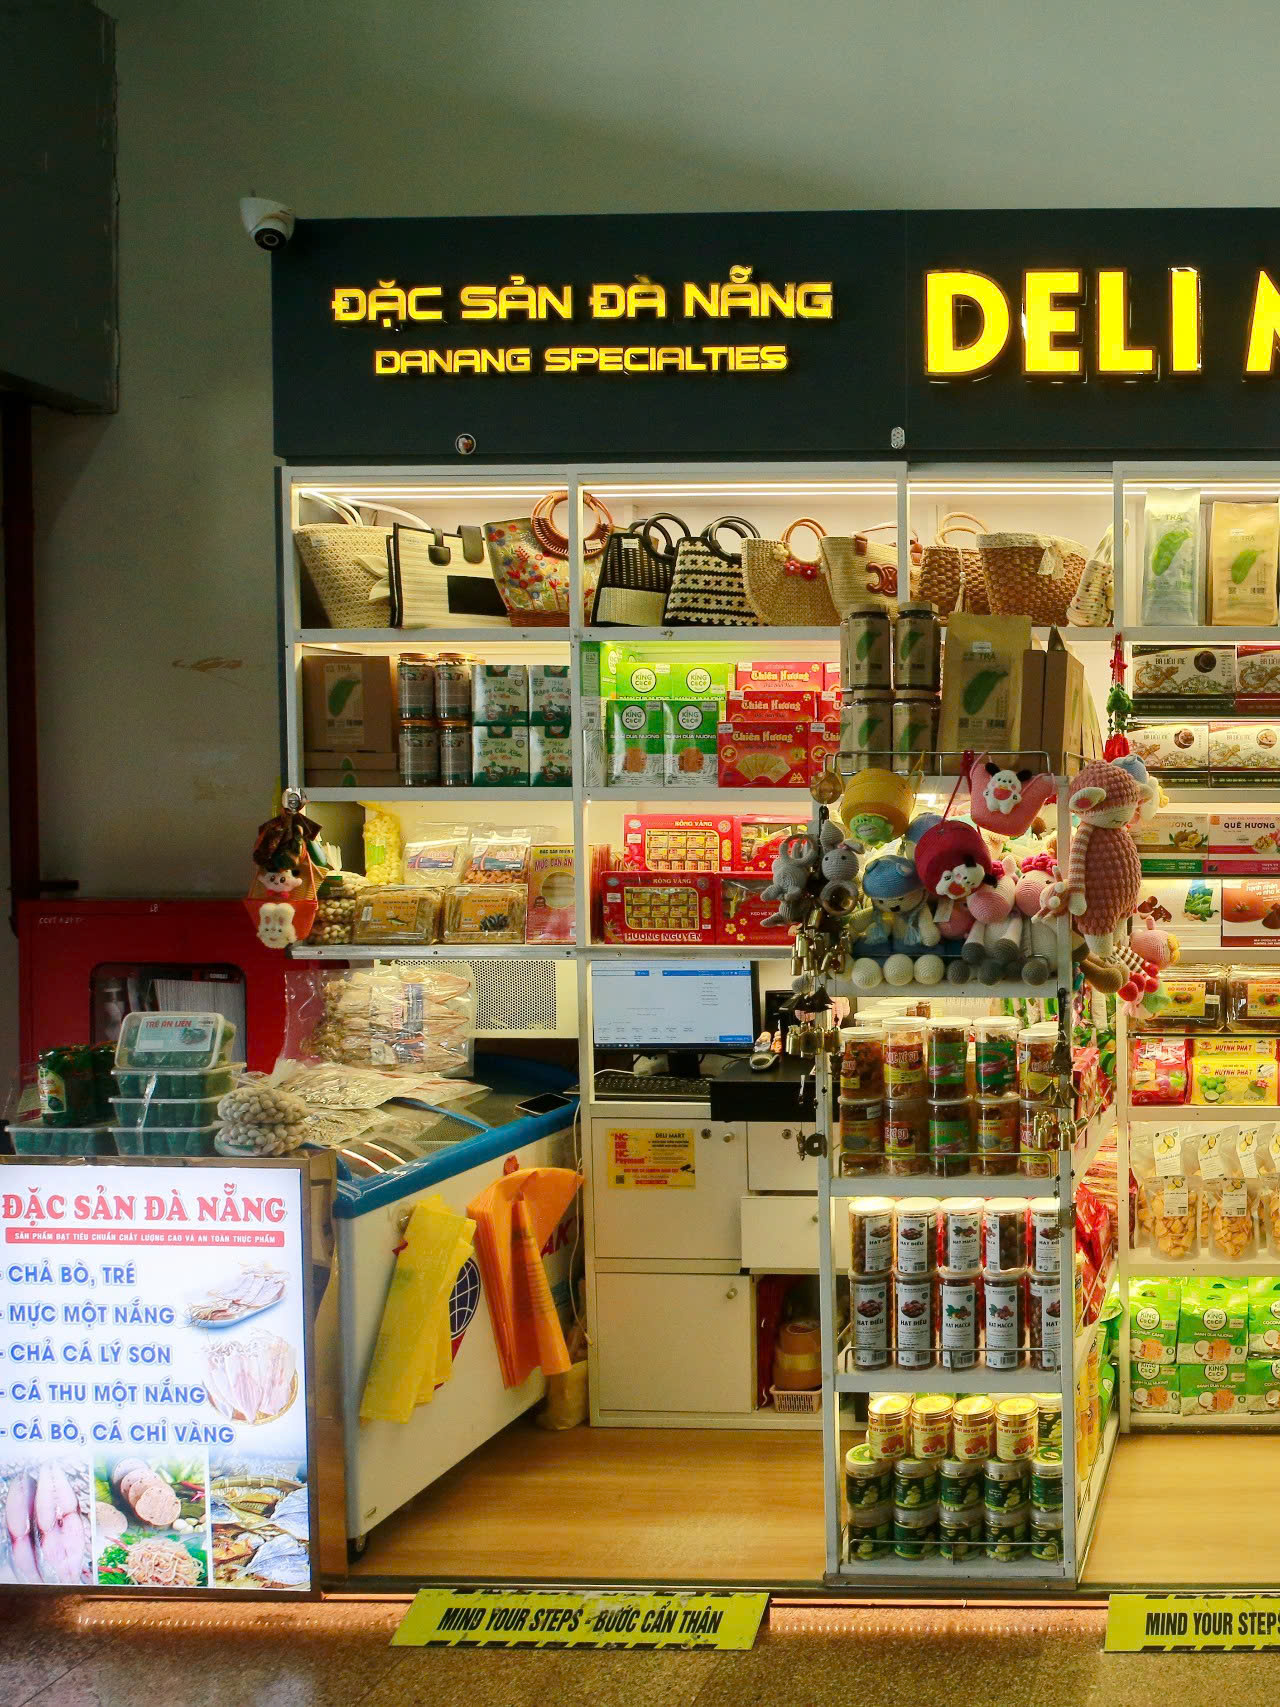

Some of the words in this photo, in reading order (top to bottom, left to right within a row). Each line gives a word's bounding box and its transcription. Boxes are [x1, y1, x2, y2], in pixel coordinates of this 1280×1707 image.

[332, 280, 443, 328] ĐẶC
[460, 274, 572, 319] SẢN
[589, 275, 666, 319] ĐÀ
[683, 265, 833, 319] NẴNG
[925, 267, 1200, 375] DELI
[375, 346, 532, 375] DANANG
[544, 344, 788, 373] SPECIALTIES
[1224, 820, 1242, 829] QUÊ
[1245, 821, 1275, 829] HƯƠNG
[2, 1186, 65, 1226] ĐẶC
[74, 1185, 136, 1221] SẢN
[144, 1188, 188, 1222] ĐÀ
[197, 1182, 286, 1223] NẴNG
[9, 1261, 53, 1283] CHẢ
[61, 1263, 96, 1287] BÒ,
[103, 1262, 136, 1284] TRÉ
[10, 1304, 56, 1327] MỰC
[64, 1302, 107, 1328] MỘT
[114, 1299, 175, 1324] NẮNG
[10, 1341, 55, 1362] CHẢ
[63, 1341, 97, 1362] CÁ
[101, 1341, 122, 1363] LÝ
[129, 1345, 171, 1363] SƠN
[11, 1376, 41, 1401] CÁ
[49, 1384, 86, 1401] THU
[96, 1381, 137, 1407] MỘT
[145, 1378, 206, 1403] NẮNG
[13, 1418, 43, 1440] CÁ
[51, 1418, 85, 1443] BÒ,
[93, 1420, 122, 1441] CÁ
[131, 1418, 167, 1441] CHỈ
[175, 1420, 234, 1443] VÀNG
[437, 1607, 480, 1631] MIND
[484, 1607, 529, 1632] YOUR
[529, 1608, 582, 1632] STEPS
[593, 1604, 639, 1633] BƯỚC
[641, 1600, 676, 1633] CẨN
[1145, 1612, 1188, 1636] MIND
[1194, 1612, 1233, 1636] YOUR
